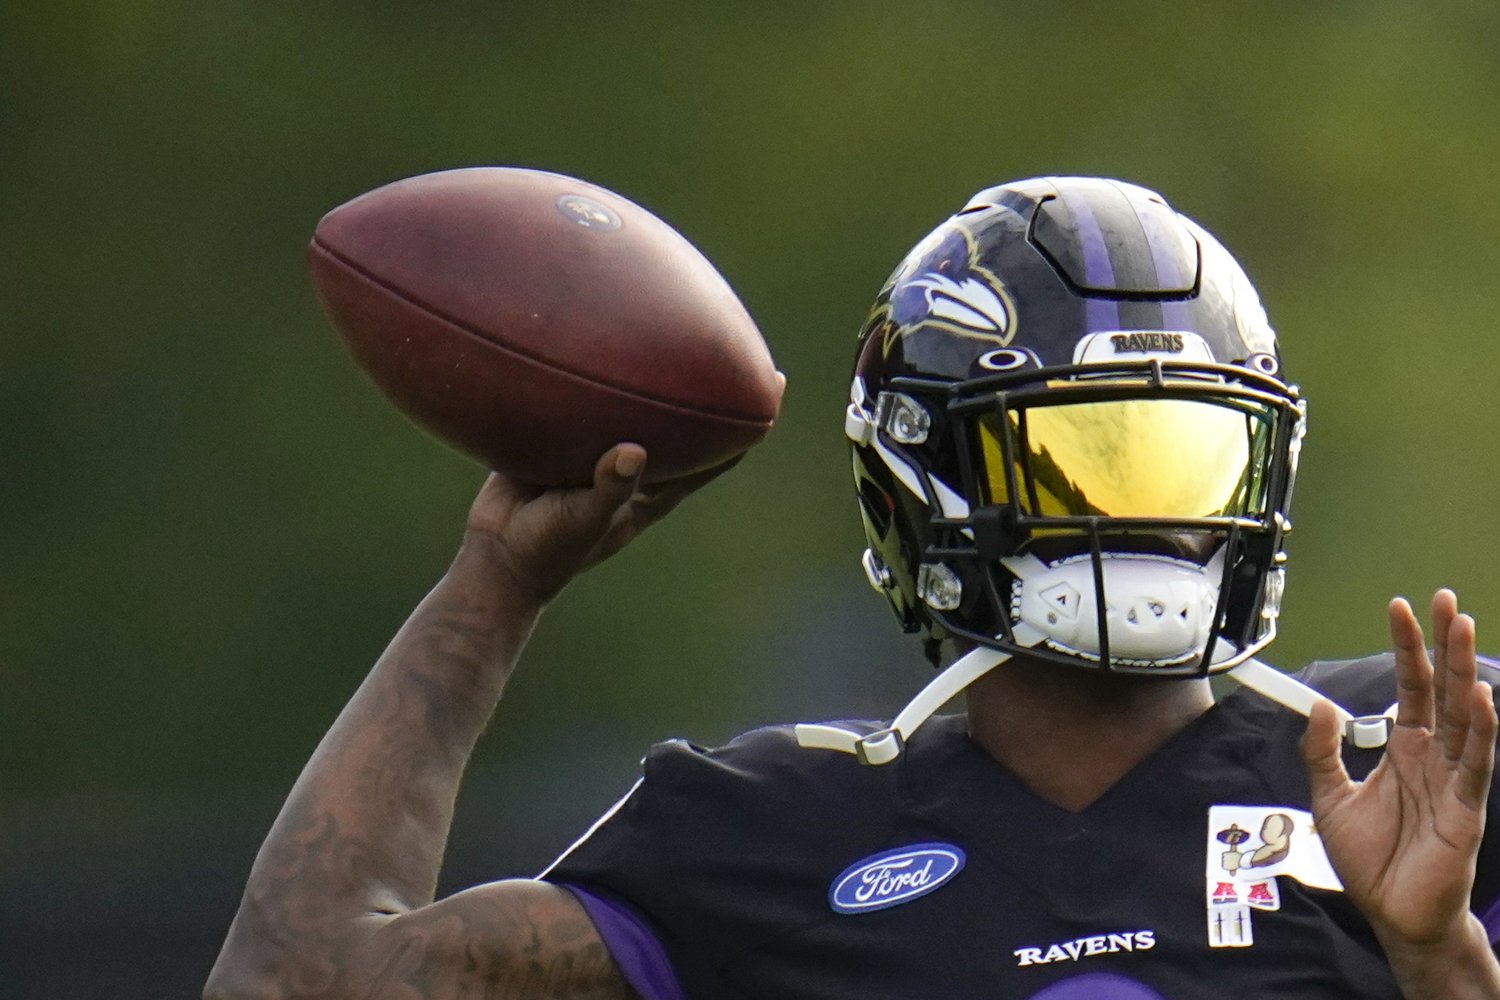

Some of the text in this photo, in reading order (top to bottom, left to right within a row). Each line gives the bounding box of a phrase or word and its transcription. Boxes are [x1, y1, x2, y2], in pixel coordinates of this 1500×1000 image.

[1110, 333, 1184, 353] RAVENS
[855, 859, 934, 902] Ford
[1013, 930, 1157, 966] RAVENS
